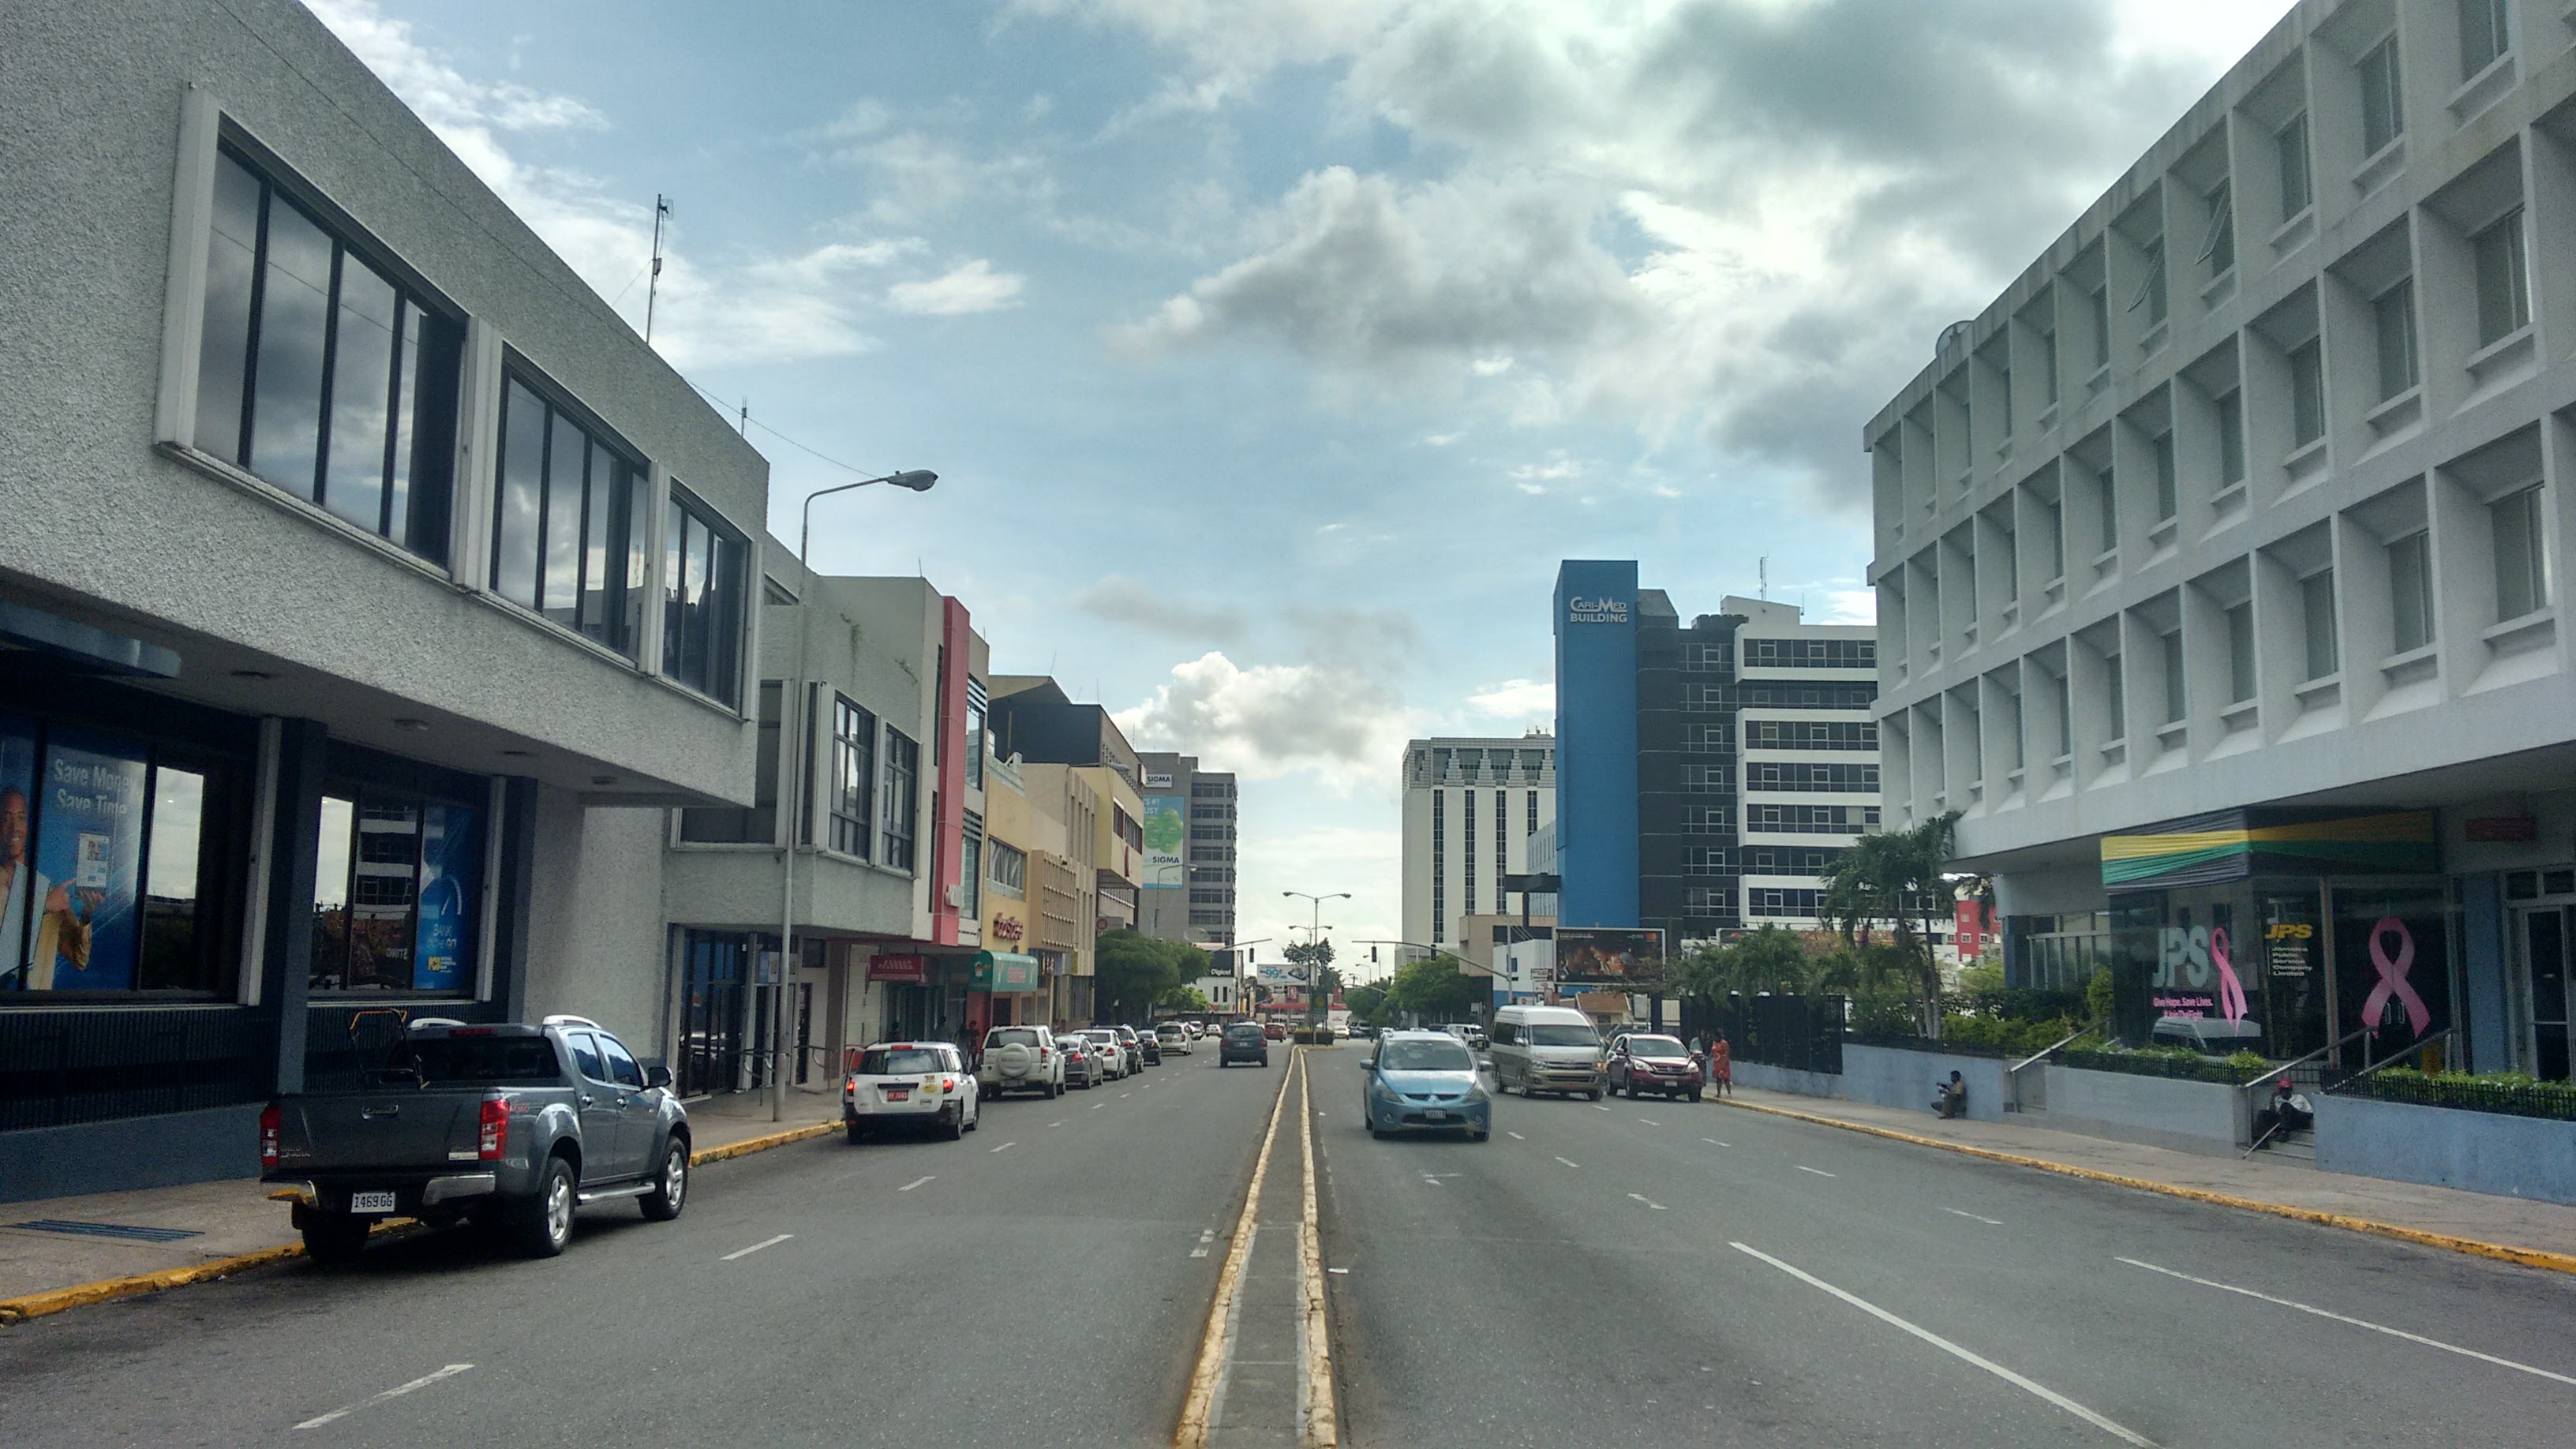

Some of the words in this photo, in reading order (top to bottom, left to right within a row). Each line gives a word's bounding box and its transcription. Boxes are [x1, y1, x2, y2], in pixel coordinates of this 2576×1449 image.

[1570, 596, 1628, 612] CARI-MED
[1570, 613, 1627, 623] BUILDING
[54, 758, 88, 786] Save
[57, 788, 92, 811] Save
[2265, 924, 2312, 939] JPS
[2152, 925, 2209, 987] JPS
[354, 1195, 379, 1208] 1469
[380, 1195, 393, 1208] GG
